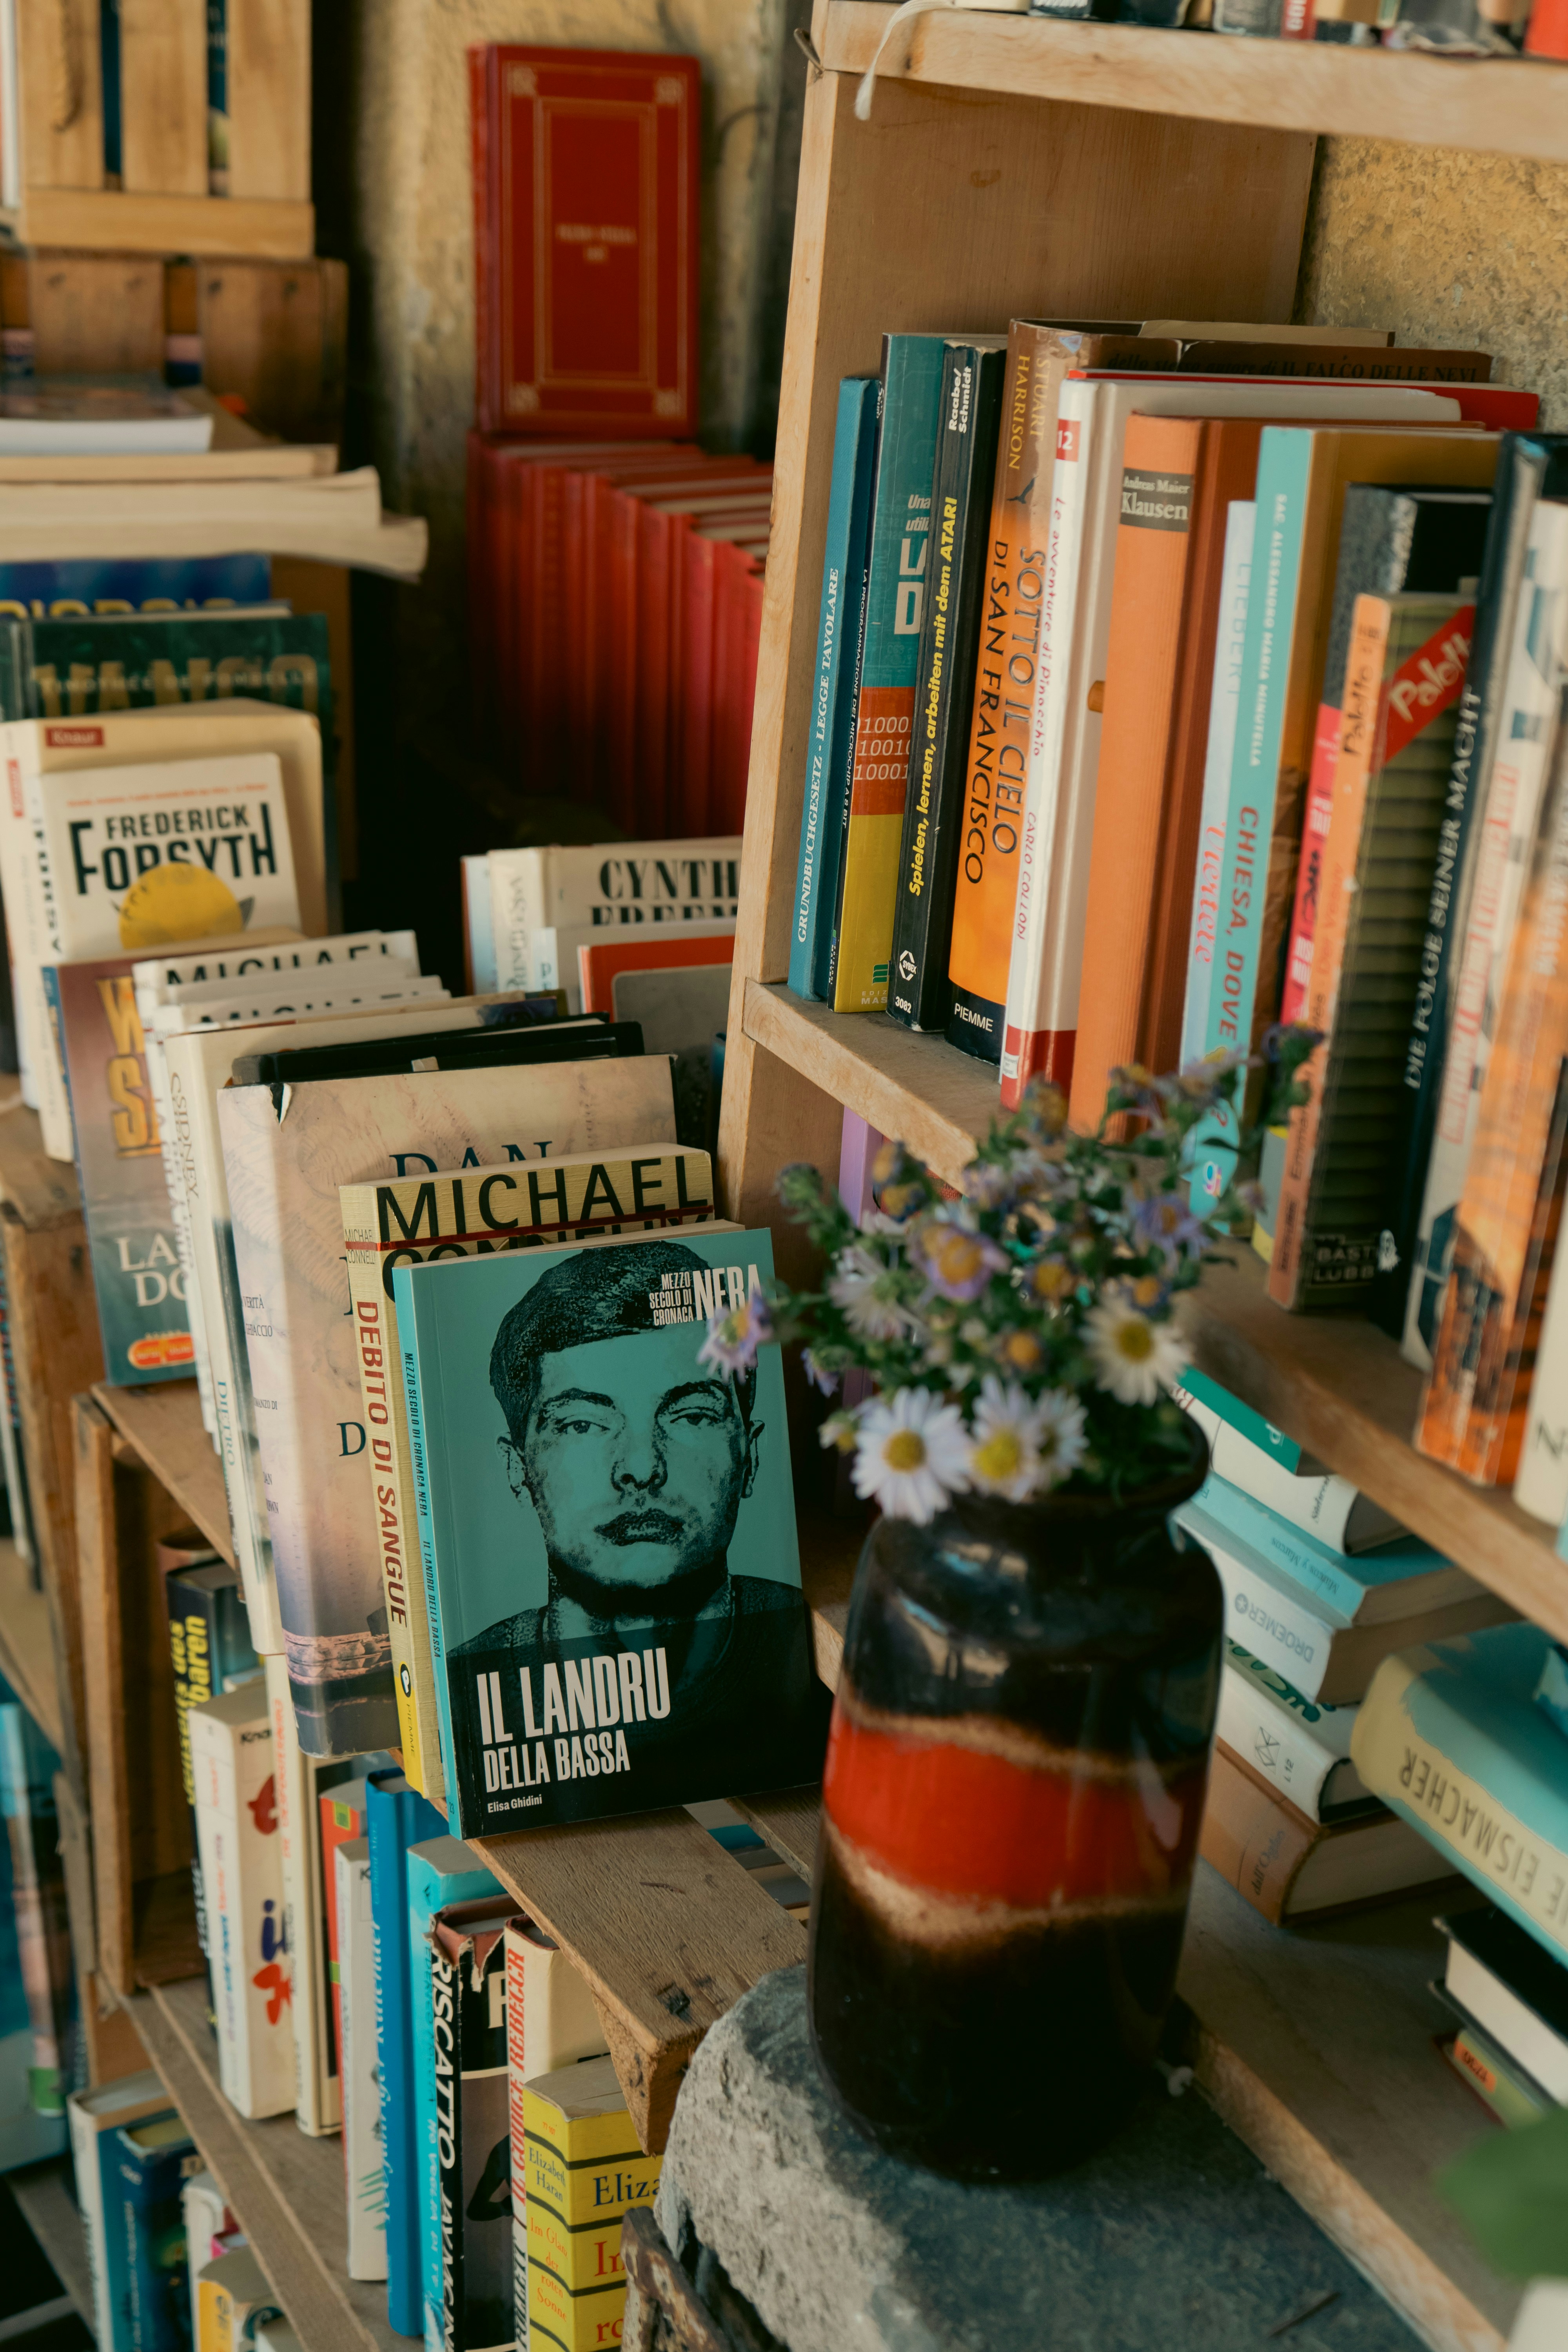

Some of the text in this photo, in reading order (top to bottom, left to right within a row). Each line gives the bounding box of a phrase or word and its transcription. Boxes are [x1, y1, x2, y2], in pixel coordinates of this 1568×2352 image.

[949, 368, 962, 431] Raabe/
[959, 366, 972, 434] Schmidt
[1030, 358, 1051, 439] STUART
[1261, 360, 1275, 376] di
[1282, 362, 1299, 376] IL
[1305, 362, 1364, 378] FALCO
[1370, 365, 1429, 381] DELLE
[1432, 367, 1477, 383] NEVI
[1009, 355, 1031, 470] HARRISON
[1057, 431, 1073, 450] 12
[908, 494, 931, 509] Una
[1054, 496, 1063, 523] Le
[1121, 491, 1189, 522] Klausen
[1123, 475, 1191, 495] Andreas Maier
[861, 569, 868, 585] LA
[1043, 529, 1060, 633] avventure
[1265, 530, 1283, 629] ALESSANDRO
[819, 568, 839, 671] TAVOLARE
[853, 586, 868, 693] PROGRAMMAZIONE
[1259, 632, 1274, 682] MARIA
[1390, 626, 1473, 720] Palett
[816, 673, 830, 741] LEGGE
[909, 496, 958, 897] Spielen, lernen, arbeiten mit dem ATARI
[964, 540, 1011, 884] DI SAN FRANCISCO
[992, 546, 1046, 854] SOTTO IL CIELO
[1033, 660, 1052, 757] Pinocchio
[1250, 685, 1266, 767] MINUTELLA
[846, 719, 856, 787] MICROCHIP
[69, 802, 278, 896] FORSYTH
[105, 805, 251, 840] FREDERICK
[799, 753, 822, 942] GRUNDBUCHGESETZ
[1016, 811, 1038, 941] CARLO COLLODI
[1404, 683, 1483, 1089] DIE FOLGE SEINER MACHT
[1219, 805, 1259, 1040] CHIESA, DOVE
[902, 959, 918, 976] SYBEX
[895, 996, 912, 1014] 3082
[954, 1002, 993, 1033] PIEMME
[179, 1095, 199, 1199] SIDNEY
[376, 1155, 708, 1242] MICHAEL
[243, 1294, 265, 1309] VERITÀ
[649, 1289, 693, 1310] SECOLO DI
[661, 1271, 691, 1290] MEZZO
[246, 1323, 273, 1337] GHIACCIO
[653, 1307, 694, 1326] CRONACA
[218, 1380, 235, 1466] DIETRO
[254, 1398, 278, 1410] MANZO DI
[404, 1352, 428, 1517] MEZZO SECOLO DI CRONACA NERA
[356, 1301, 408, 1628] DEBITO DI SANGUE
[423, 1541, 441, 1659] IL LANDRU DELLA BASSA
[1247, 1599, 1314, 1664] DROEMER
[477, 1647, 671, 1745] IL LANDRU
[407, 1704, 416, 1758] PIEMME
[483, 1729, 631, 1793] DELLA BASSA
[487, 1794, 543, 1813] Elisa Ghidini
[1399, 1745, 1539, 1896] EISMACHER
[424, 1946, 436, 2025] EDERICO
[507, 1947, 525, 2073] REBECCA
[431, 1952, 455, 2169] RISCATTO
[510, 2074, 525, 2173] CODICE
[528, 2147, 566, 2188] Elizabeth
[536, 2170, 563, 2203] Haran
[530, 2217, 544, 2235] Im
[513, 2236, 528, 2349] FOLLETT
[541, 2274, 564, 2299] roten
[545, 2252, 559, 2272] der
[537, 2287, 567, 2322] Sonne
